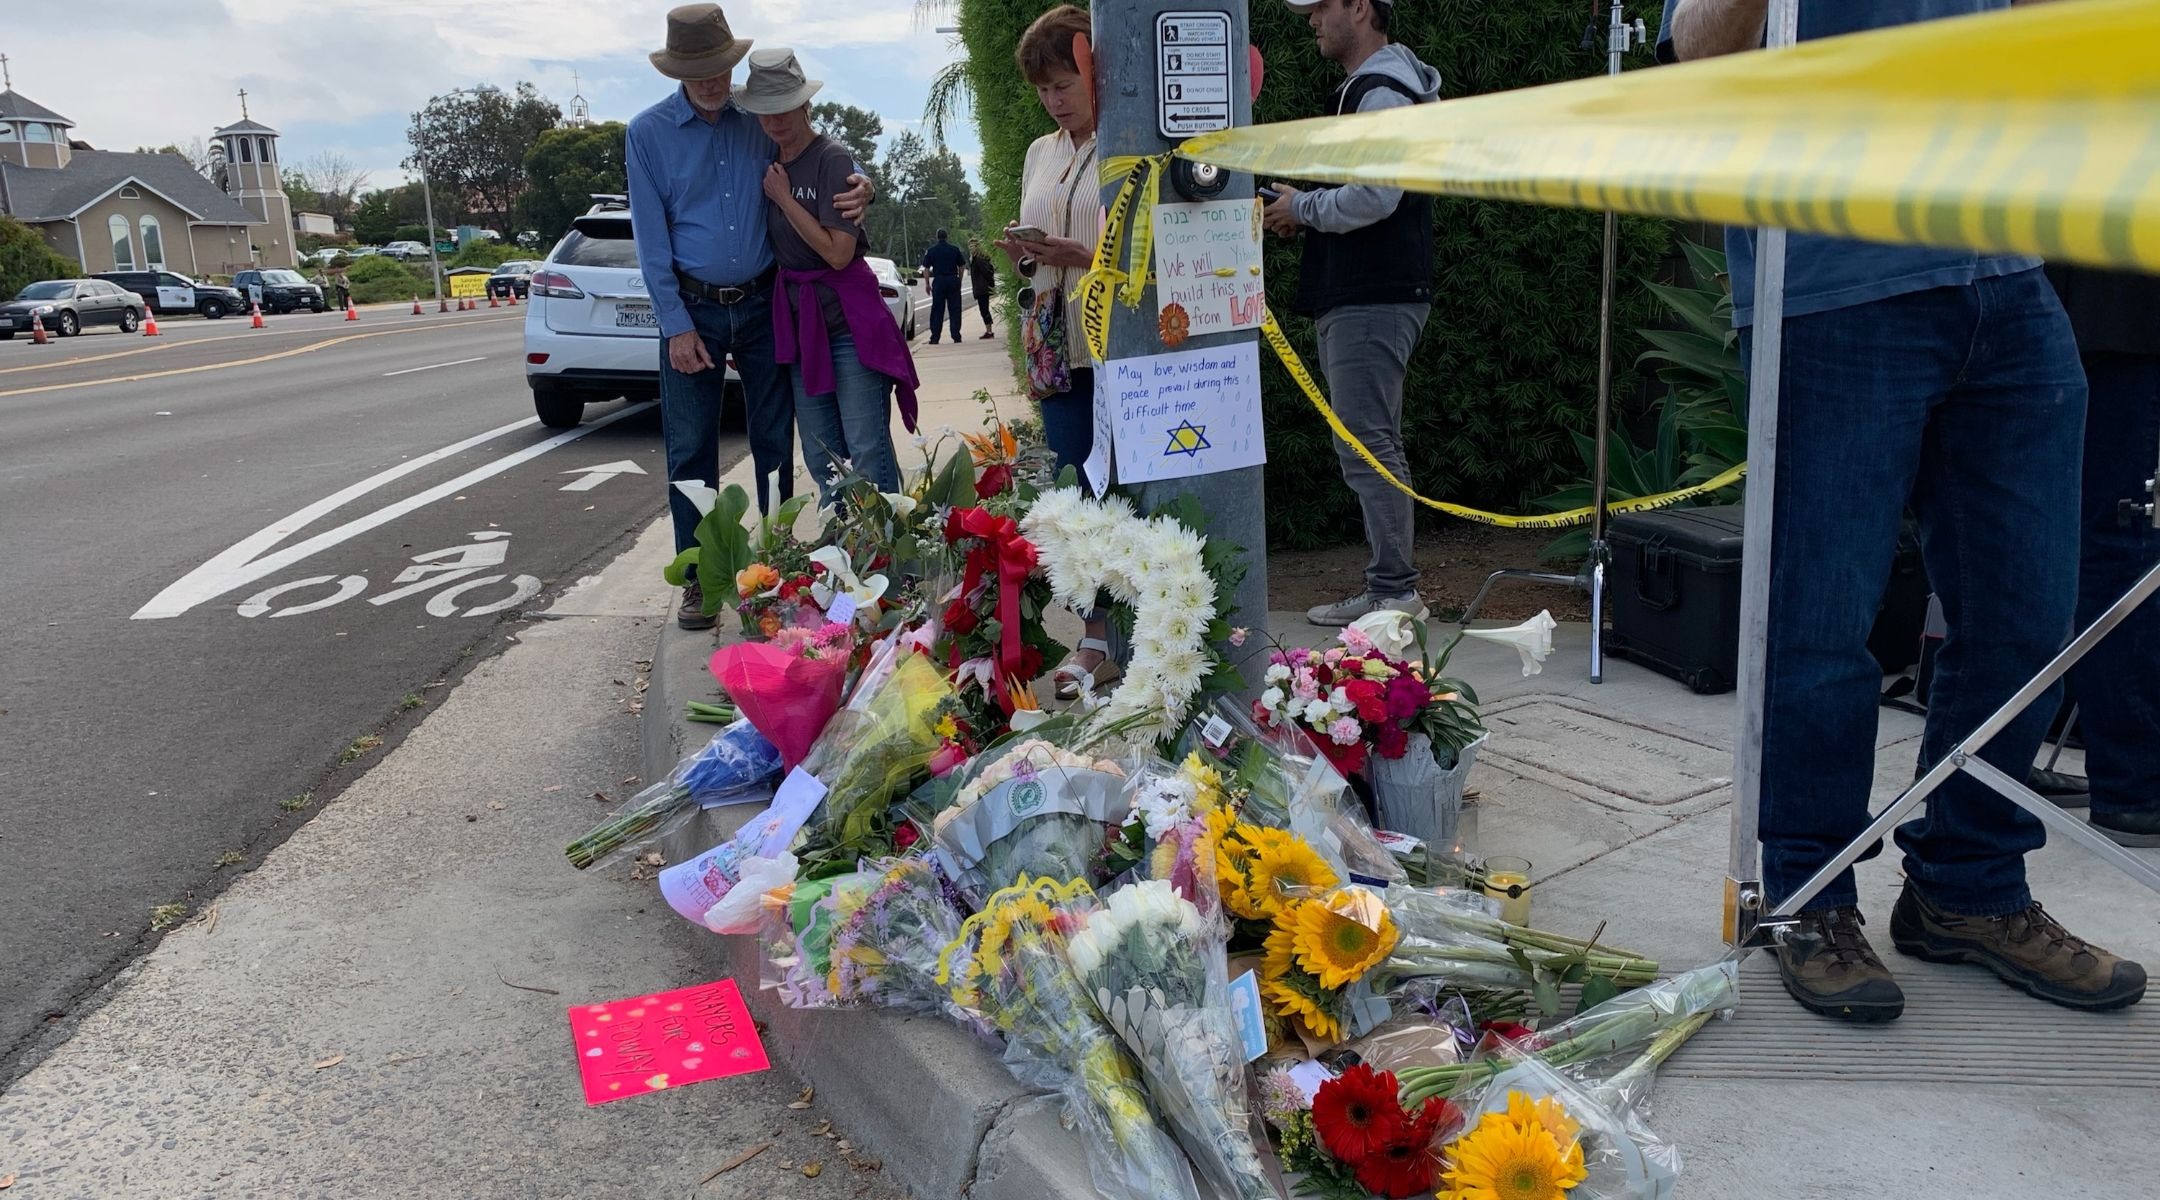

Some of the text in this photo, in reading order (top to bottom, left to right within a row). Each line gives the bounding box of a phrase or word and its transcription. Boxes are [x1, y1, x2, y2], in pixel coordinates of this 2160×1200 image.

[1183, 106, 1191, 114] TO
[1164, 228, 1245, 246] Olam Chesed
[1163, 250, 1214, 279] We will
[1171, 282, 1203, 304] build
[1211, 281, 1235, 299] this
[1192, 291, 1265, 327] from LOVE
[1118, 355, 1236, 387] May love, wisdom and
[1120, 375, 1240, 407] peace prevail during this
[1123, 403, 1170, 421] difficult
[1546, 718, 1689, 764] TRAFFIC SIGNAL
[599, 1021, 658, 1078] POWAY
